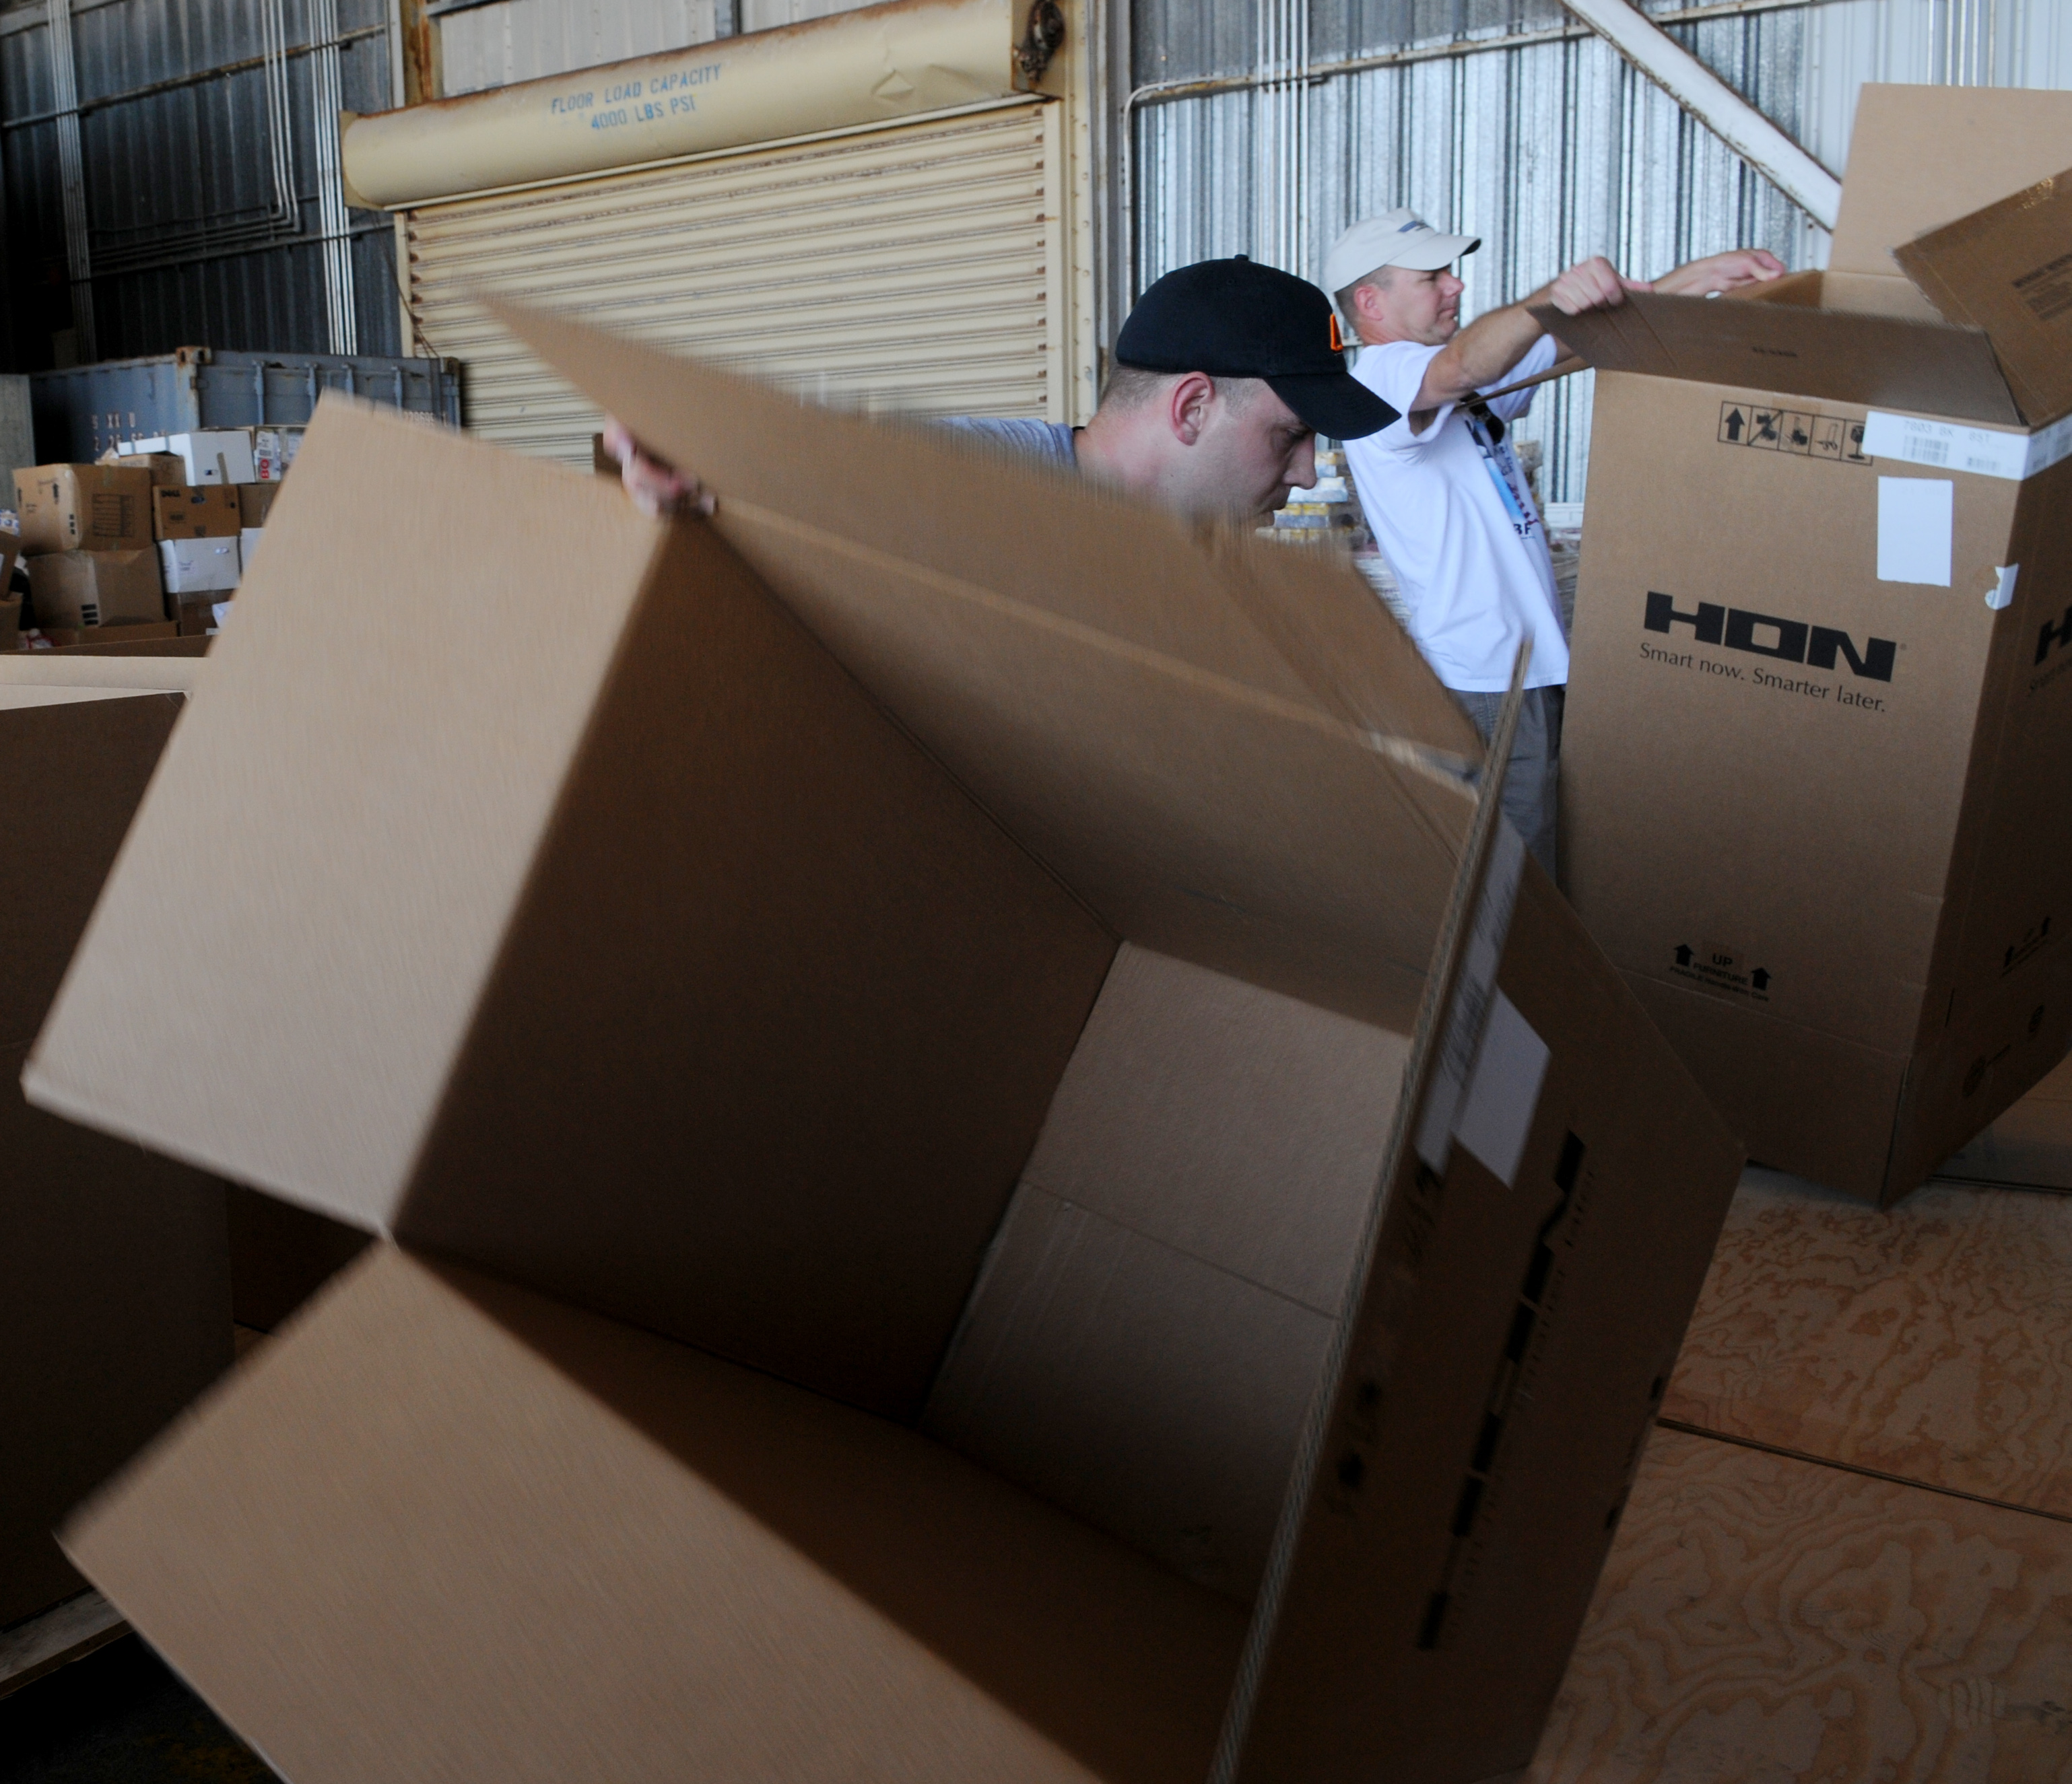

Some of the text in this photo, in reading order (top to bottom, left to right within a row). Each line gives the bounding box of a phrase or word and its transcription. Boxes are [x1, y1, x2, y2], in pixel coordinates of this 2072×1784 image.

[551, 63, 722, 114] FLOOR LOAD CAPACITY
[591, 94, 696, 130] 4000 LBS PSI
[1644, 590, 1897, 683] HON
[1639, 642, 1886, 712] Smart now. Smarter later.
[1712, 953, 1733, 967] UP
